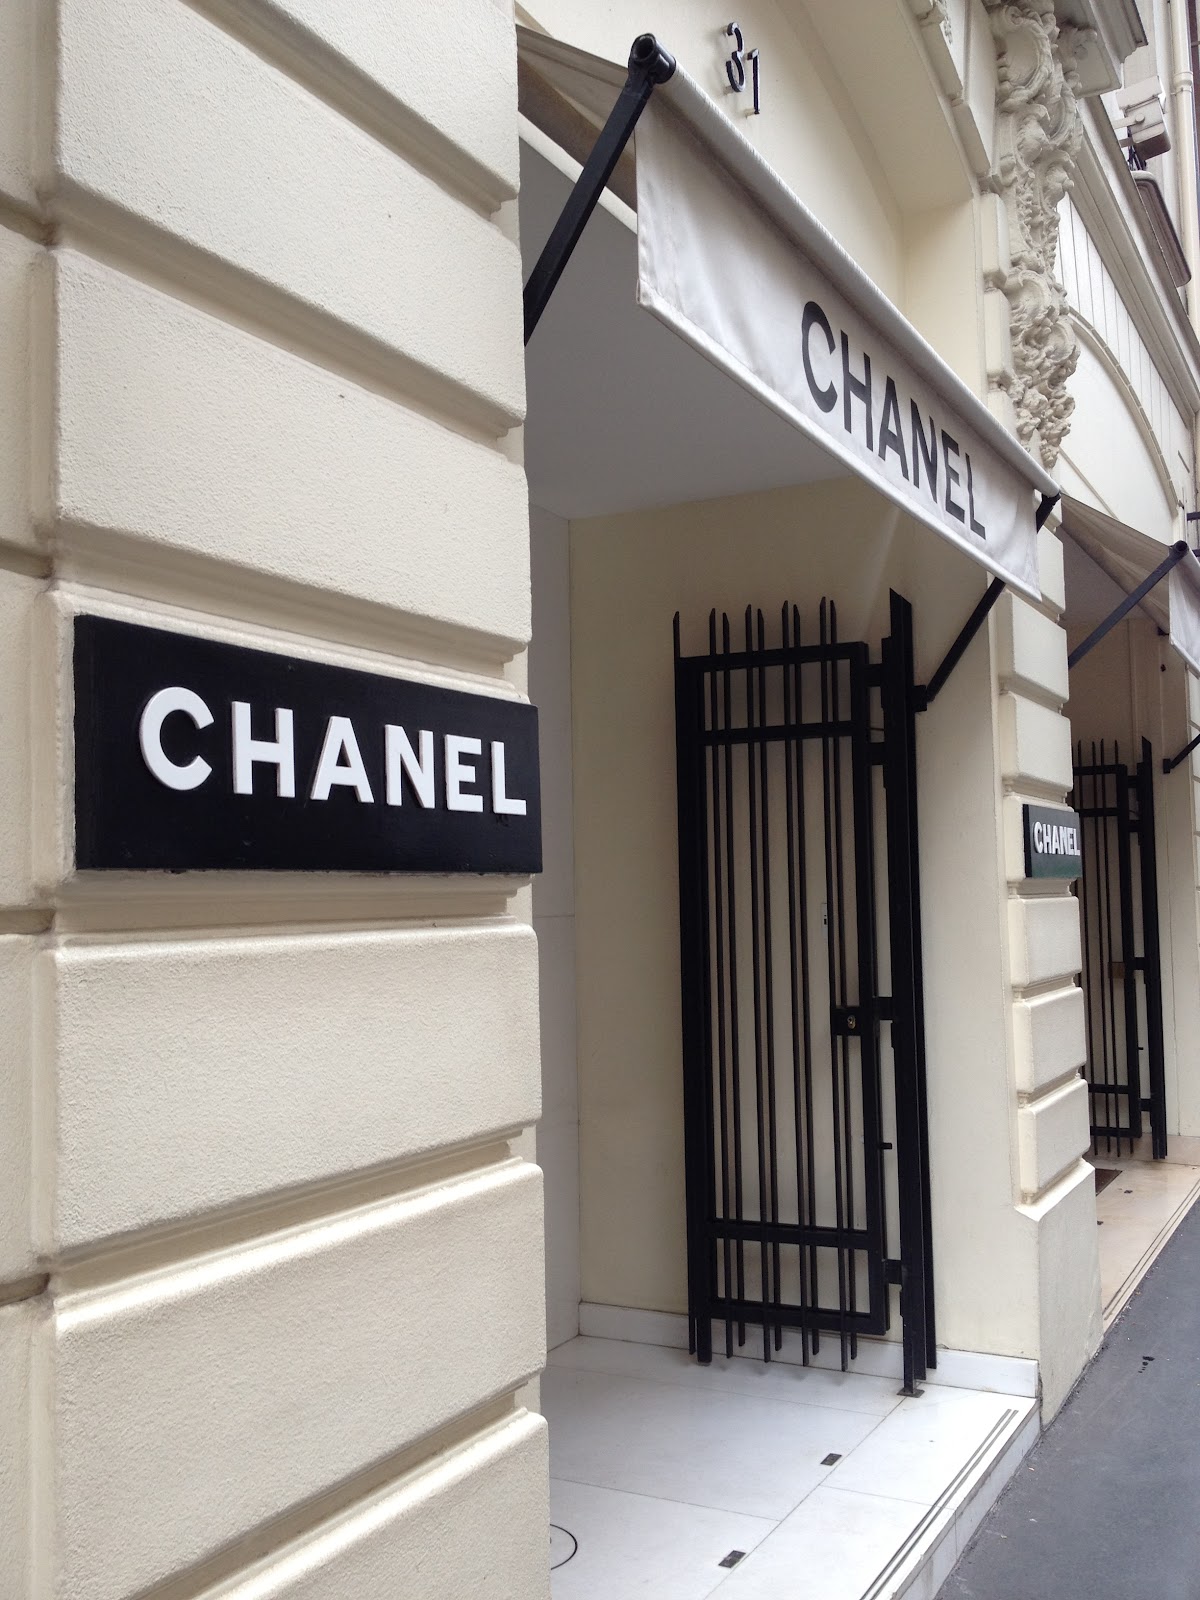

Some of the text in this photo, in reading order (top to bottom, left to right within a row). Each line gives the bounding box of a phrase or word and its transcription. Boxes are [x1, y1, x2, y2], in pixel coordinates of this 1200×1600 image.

[726, 22, 760, 115] 31
[801, 300, 986, 541] CHANEL
[138, 686, 527, 816] CHANEL
[1033, 821, 1081, 856] CHANEL
